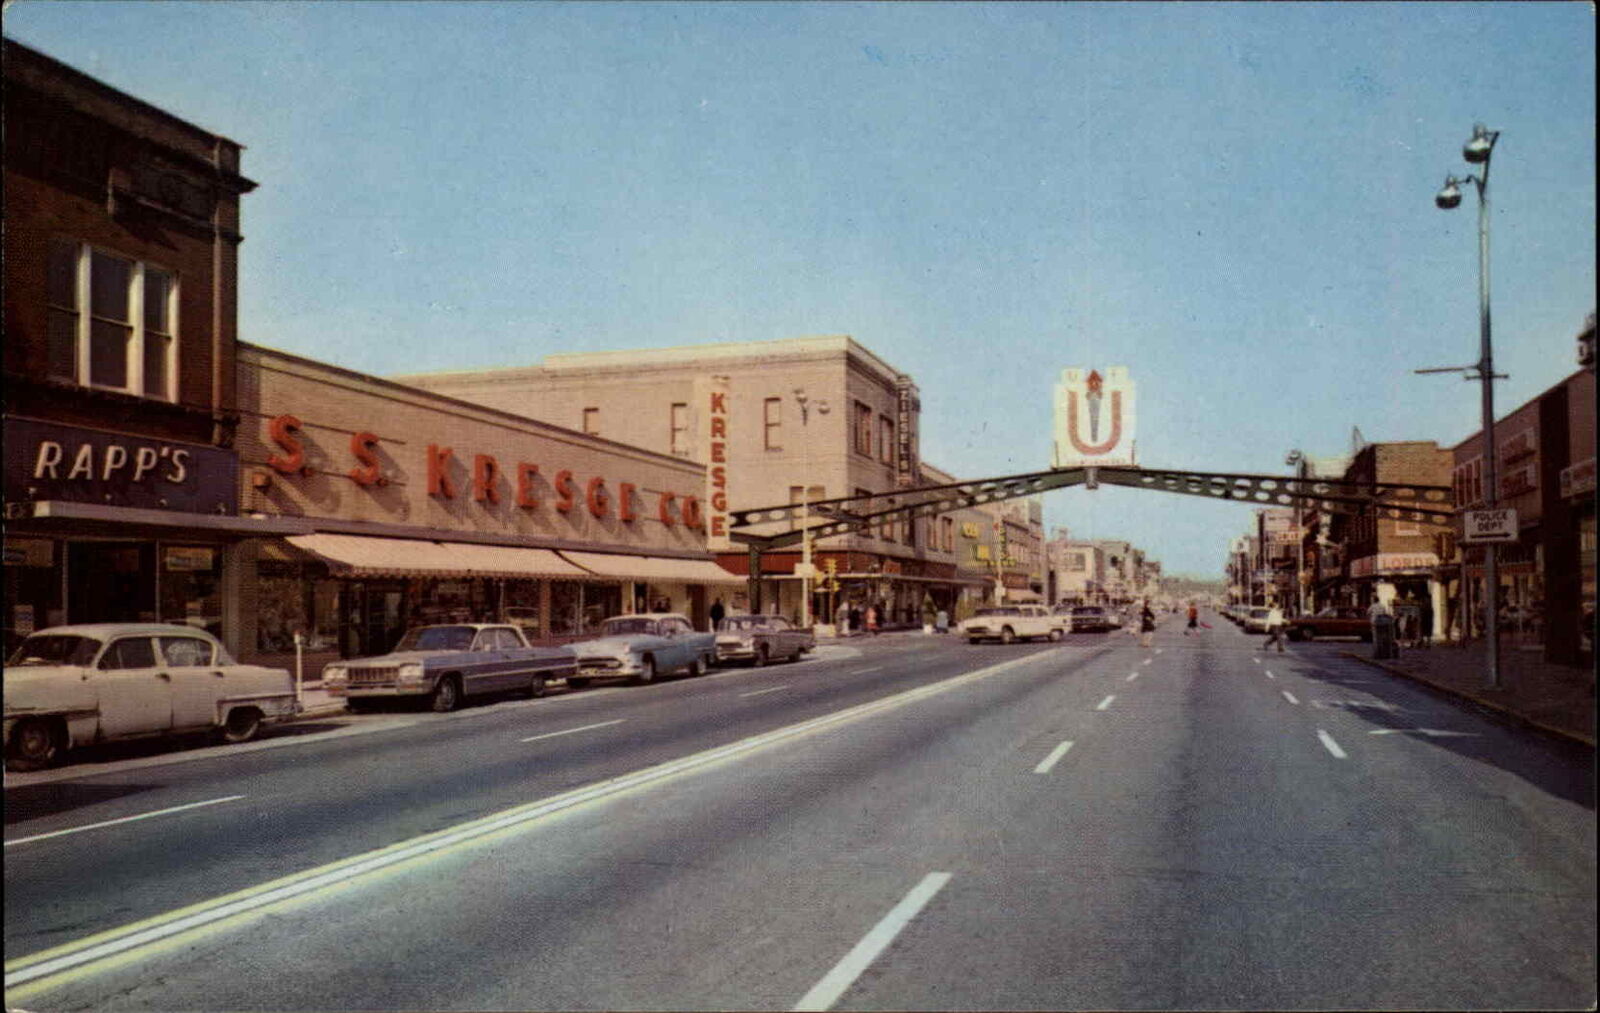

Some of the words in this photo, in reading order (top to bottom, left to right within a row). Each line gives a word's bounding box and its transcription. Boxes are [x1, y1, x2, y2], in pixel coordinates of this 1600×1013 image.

[33, 441, 190, 483] RAPP'S
[426, 443, 637, 523] KRESGE
[710, 391, 727, 537] KRESGE
[1472, 511, 1507, 522] POLICE
